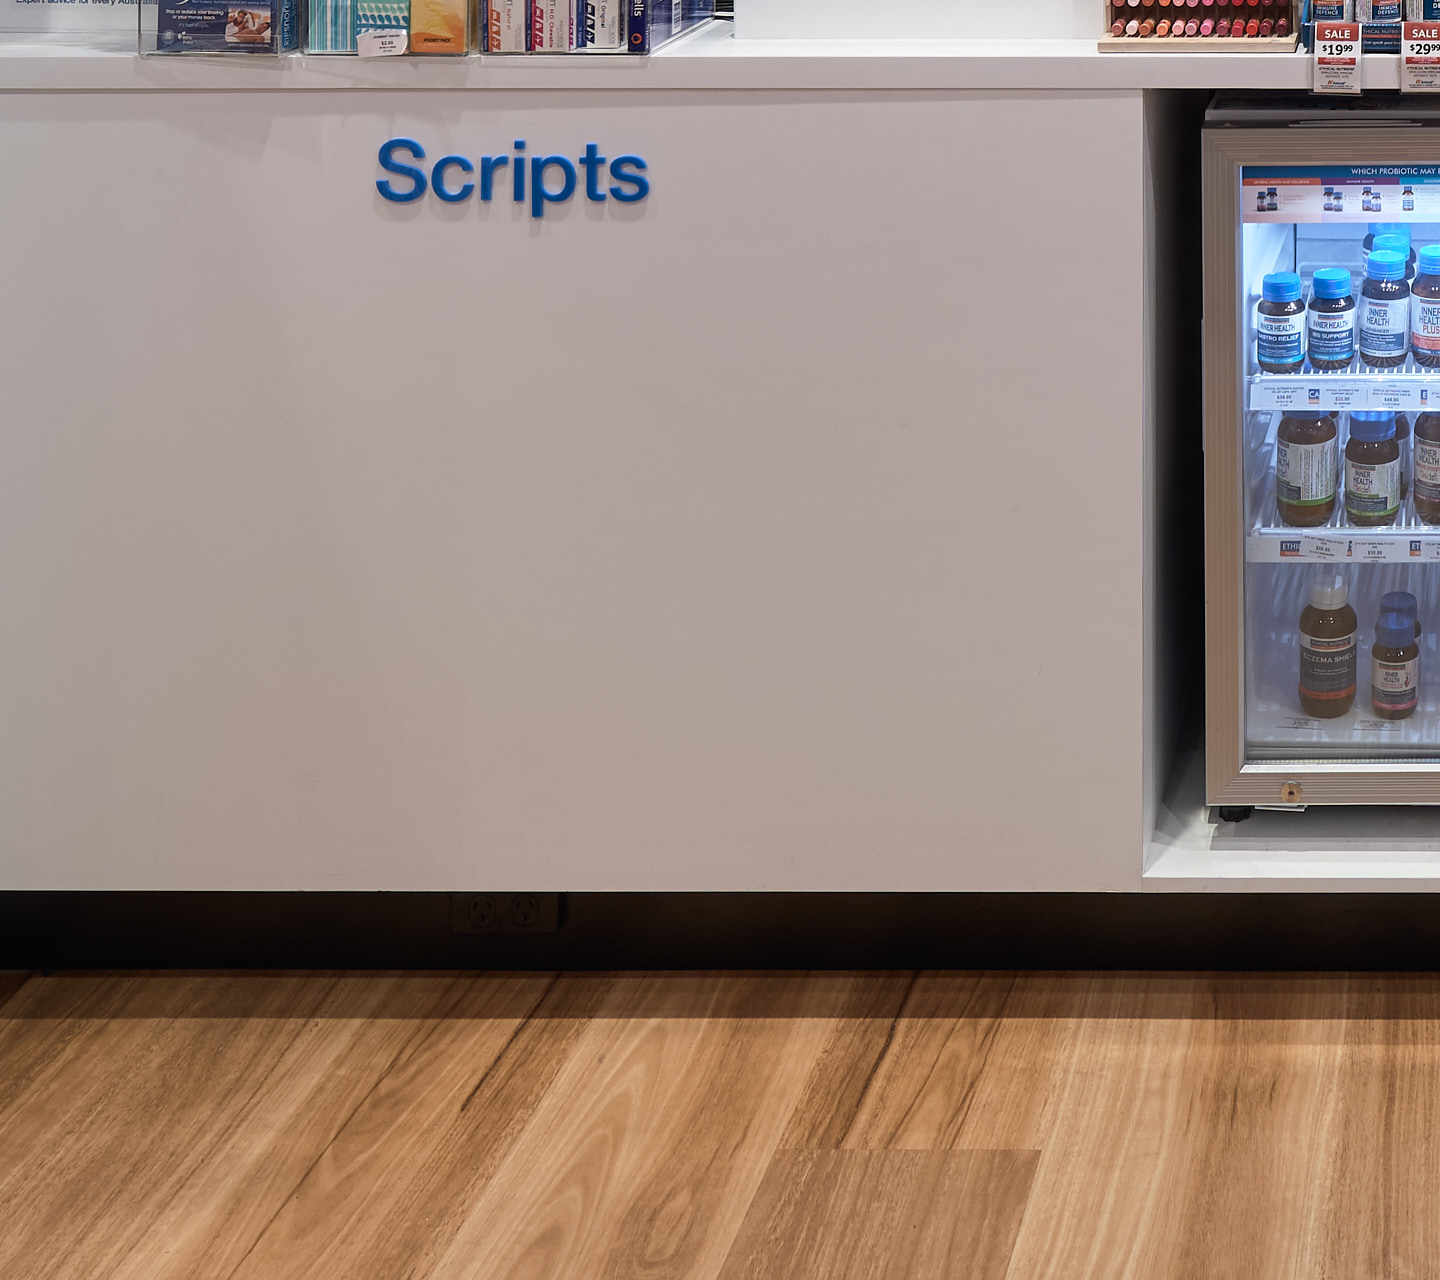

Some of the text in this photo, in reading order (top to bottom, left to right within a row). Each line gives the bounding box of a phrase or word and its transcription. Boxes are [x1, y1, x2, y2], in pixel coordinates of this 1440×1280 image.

[1324, 29, 1351, 39] SALE
[1412, 28, 1438, 38] SALE
[1351, 167, 1377, 175] WHICH
[1379, 167, 1417, 175] PROBIOTIC
[1418, 167, 1436, 175] MAY
[375, 137, 650, 218] Scripts
[1422, 325, 1440, 334] PLUS
